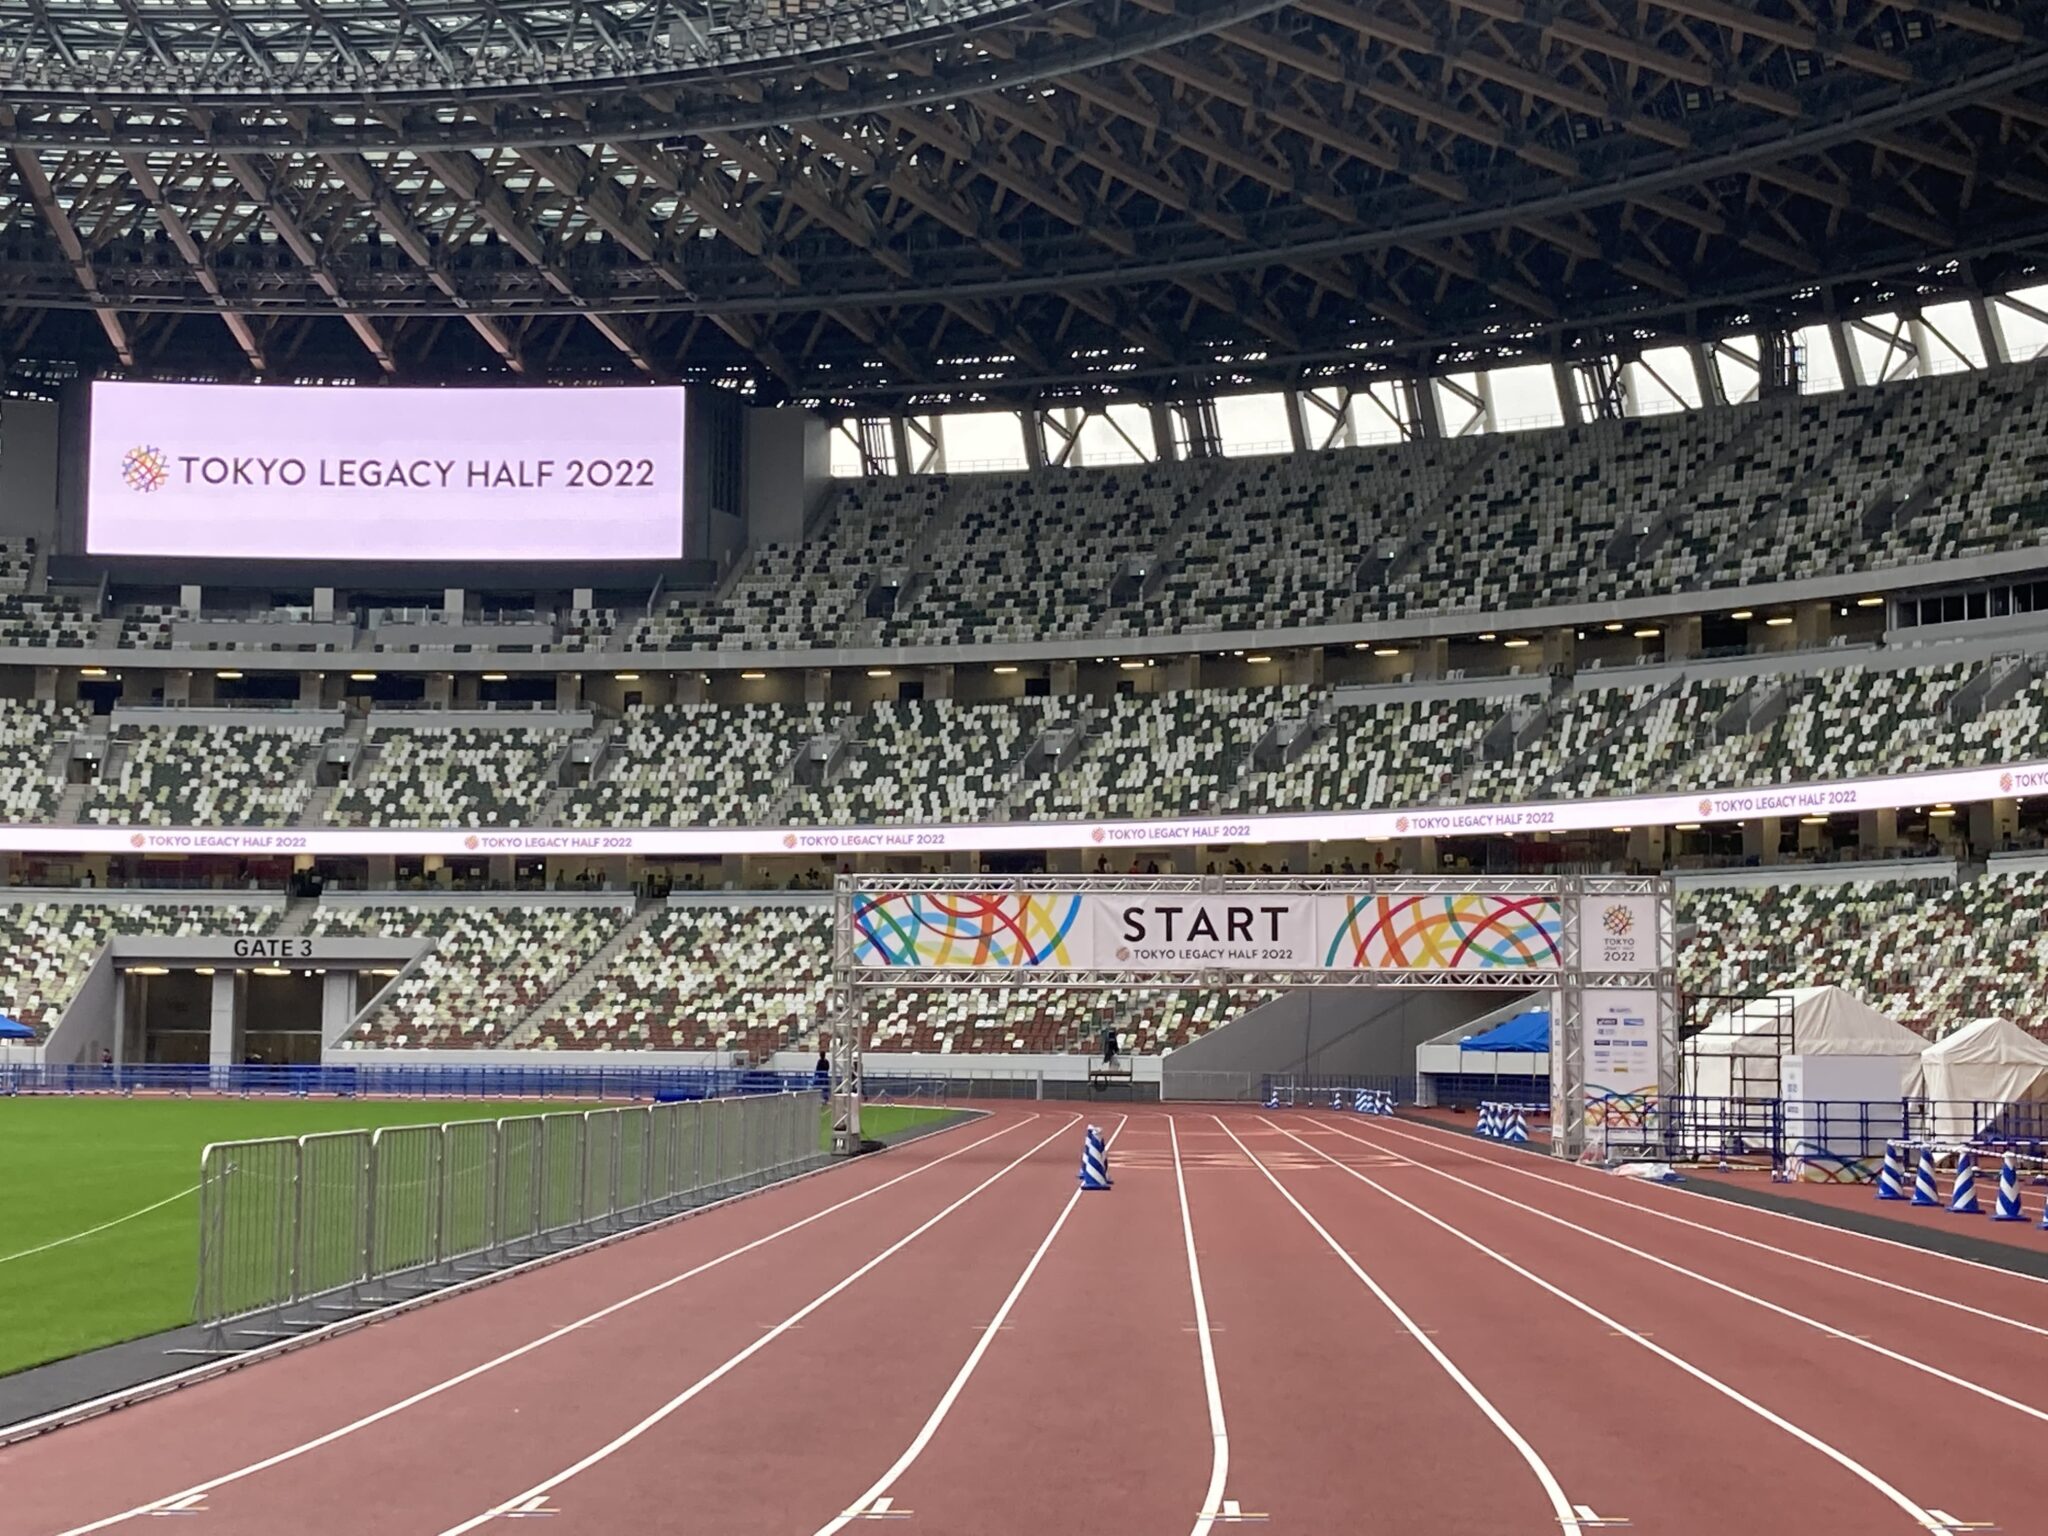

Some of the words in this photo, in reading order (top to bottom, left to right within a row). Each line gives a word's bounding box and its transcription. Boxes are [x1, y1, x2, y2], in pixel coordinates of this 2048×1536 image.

[178, 456, 306, 487] TOKYO
[320, 459, 456, 488] LEGACY
[467, 460, 554, 488] HALF
[565, 459, 655, 488] 2022
[1715, 799, 1753, 812] TOKYO
[1755, 796, 1797, 810] LEGACY
[1799, 793, 1826, 807] HALF
[1828, 790, 1857, 804] 2022
[1412, 817, 1450, 829] TOKYO
[1452, 815, 1493, 827] LEGACY
[1496, 813, 1523, 825] HALF
[1526, 812, 1554, 824] 2022
[1107, 829, 1146, 840] TOKYO
[1148, 827, 1190, 839] LEGACY
[1192, 826, 1220, 837] HALF
[1222, 825, 1250, 836] 2022
[148, 835, 191, 846] TOKYO
[193, 836, 241, 847] LEGACY
[243, 836, 273, 847] HALF
[275, 837, 307, 848] 2022
[481, 837, 522, 847] TOKYO
[525, 837, 569, 848] LEGACY
[571, 837, 600, 847] HALF
[602, 837, 632, 848] 2022
[800, 836, 839, 846] TOKYO
[841, 835, 884, 846] LEGACY
[886, 834, 914, 845] HALF
[916, 834, 945, 845] 2022
[1123, 906, 1289, 942] START
[234, 938, 293, 957] GATE
[300, 939, 312, 957] 3
[1604, 938, 1635, 946] TOKYO
[1134, 949, 1176, 959] TOKYO
[1179, 949, 1224, 960] LEGACY
[1228, 949, 1258, 960] HALF
[1262, 949, 1293, 959] 2022
[1604, 951, 1635, 962] 2022
